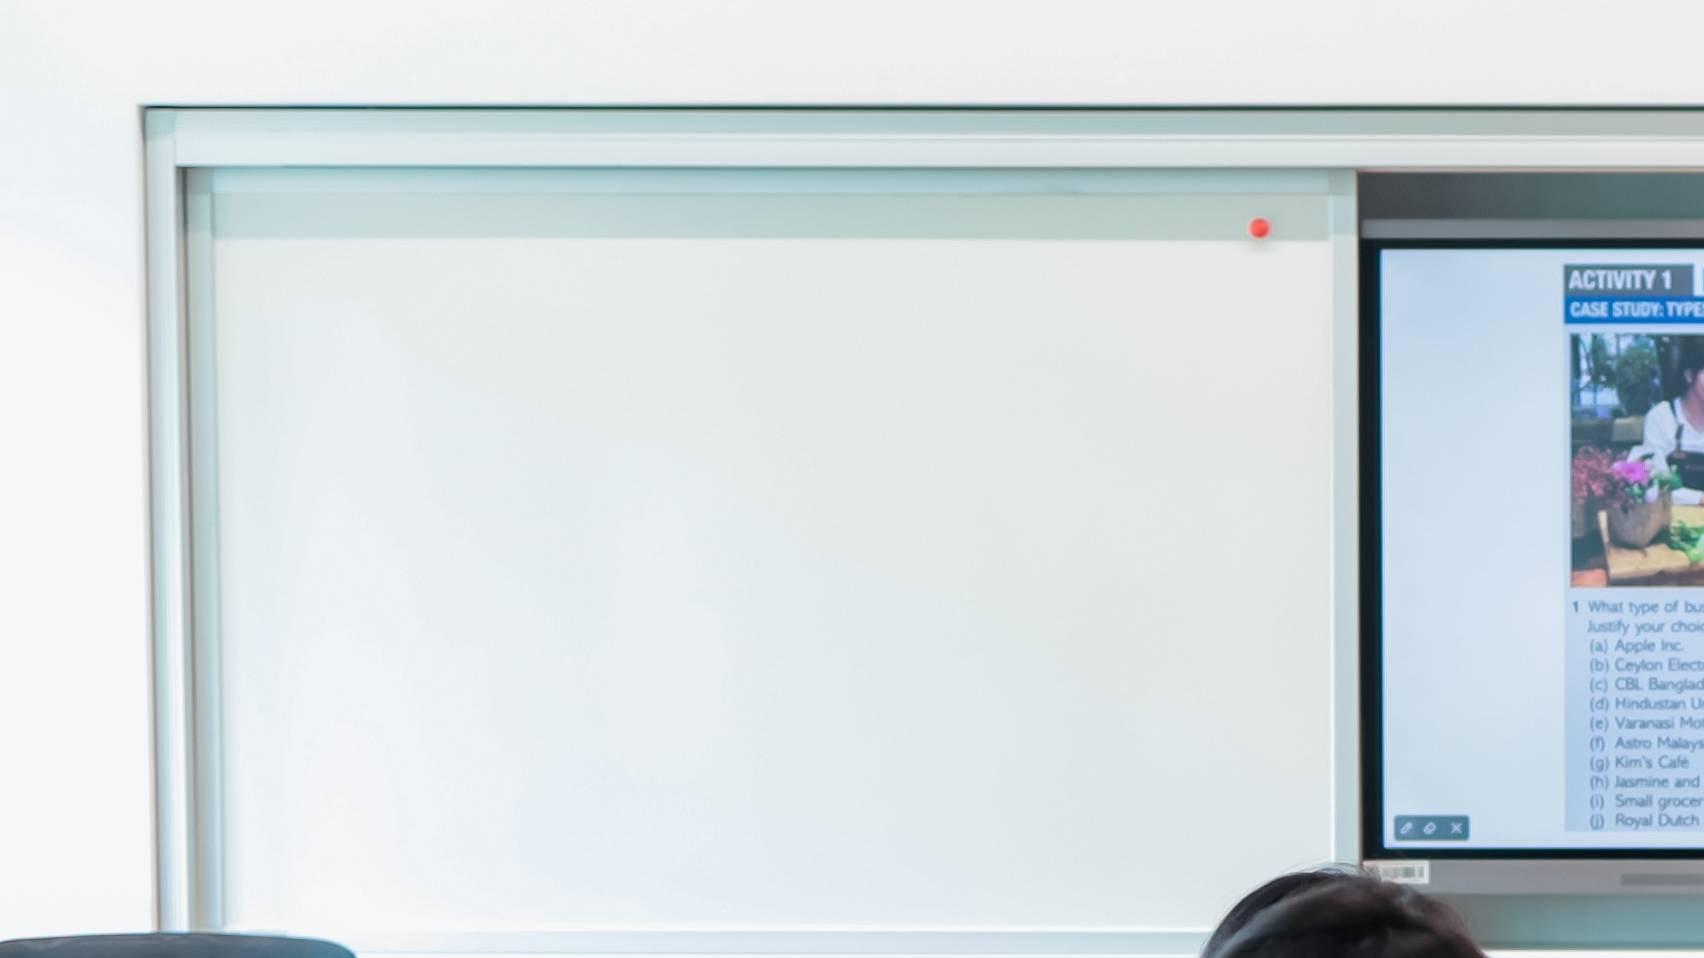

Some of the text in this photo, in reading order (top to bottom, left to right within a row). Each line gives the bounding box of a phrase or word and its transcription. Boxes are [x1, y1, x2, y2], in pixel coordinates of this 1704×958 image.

[1568, 270, 1672, 290] ACTIVITY 1
[1570, 302, 1609, 317] CASE
[1613, 302, 1664, 317] STUDY:
[1571, 600, 1580, 613] 1
[1587, 599, 1624, 613] What
[1628, 601, 1660, 616] type
[1663, 599, 1679, 613] of
[1587, 618, 1631, 636] Justify
[1634, 622, 1666, 636] your
[1589, 638, 1684, 654] (a) Apple Inc.
[1589, 657, 1610, 673] (b)
[1614, 656, 1664, 674] Ceylon
[1589, 677, 1609, 693] (c)
[1614, 676, 1644, 691] CBL
[1589, 696, 1610, 712] (d)
[1615, 696, 1687, 710] Hindustan
[1589, 716, 1610, 732] (e)
[1614, 715, 1675, 729] Varanasi
[1589, 735, 1606, 752] (f)
[1614, 735, 1653, 749] Astro
[1589, 754, 1690, 772] (g) Kim's Café
[1589, 775, 1610, 790] (h)
[1614, 775, 1670, 788] Jasmine
[1673, 775, 1701, 788] and
[1589, 794, 1605, 810] (i)
[1615, 793, 1654, 807] Small
[1589, 813, 1606, 830] (j)
[1614, 812, 1654, 830] Royal
[1657, 812, 1701, 828] Dutch
